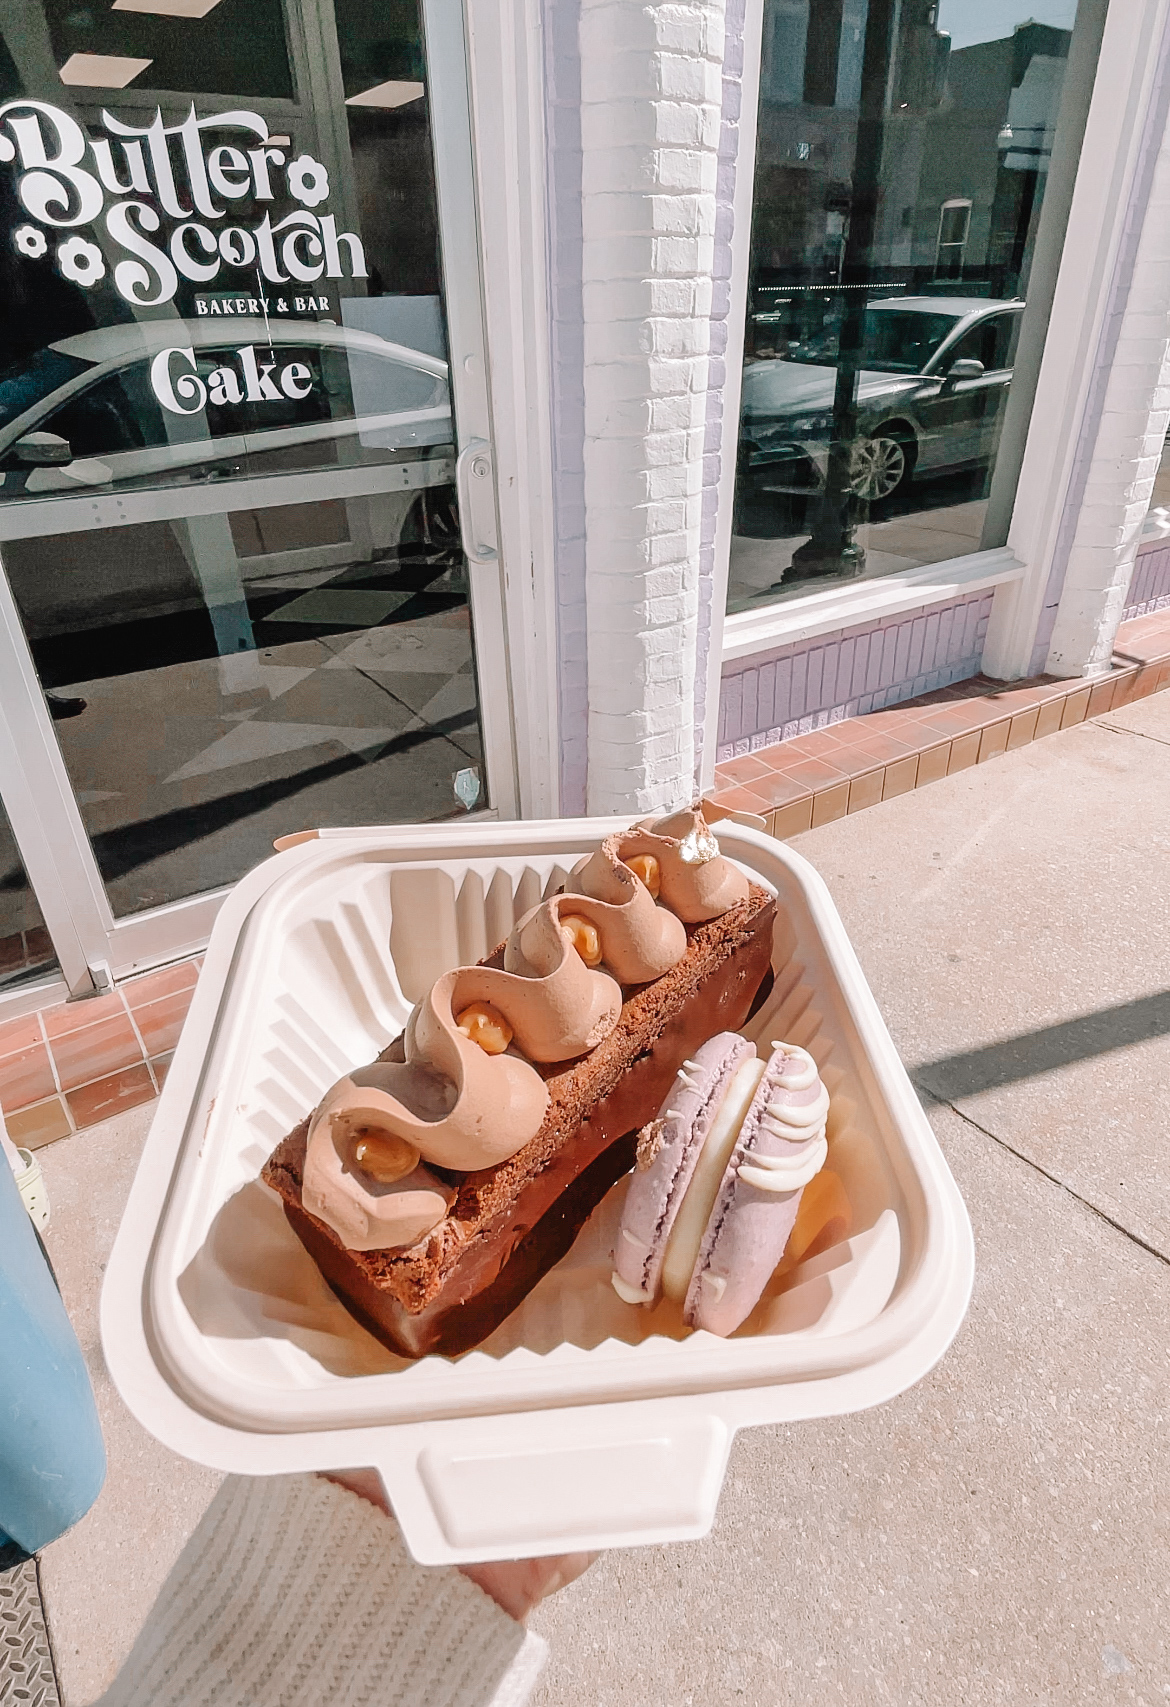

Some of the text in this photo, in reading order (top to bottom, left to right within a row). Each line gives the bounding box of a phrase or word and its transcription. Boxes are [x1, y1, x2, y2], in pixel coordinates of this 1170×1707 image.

[0, 100, 285, 226] Butter
[106, 201, 369, 306] Scotch
[196, 296, 330, 315] BAKERY & BAR
[150, 345, 313, 415] Cake
